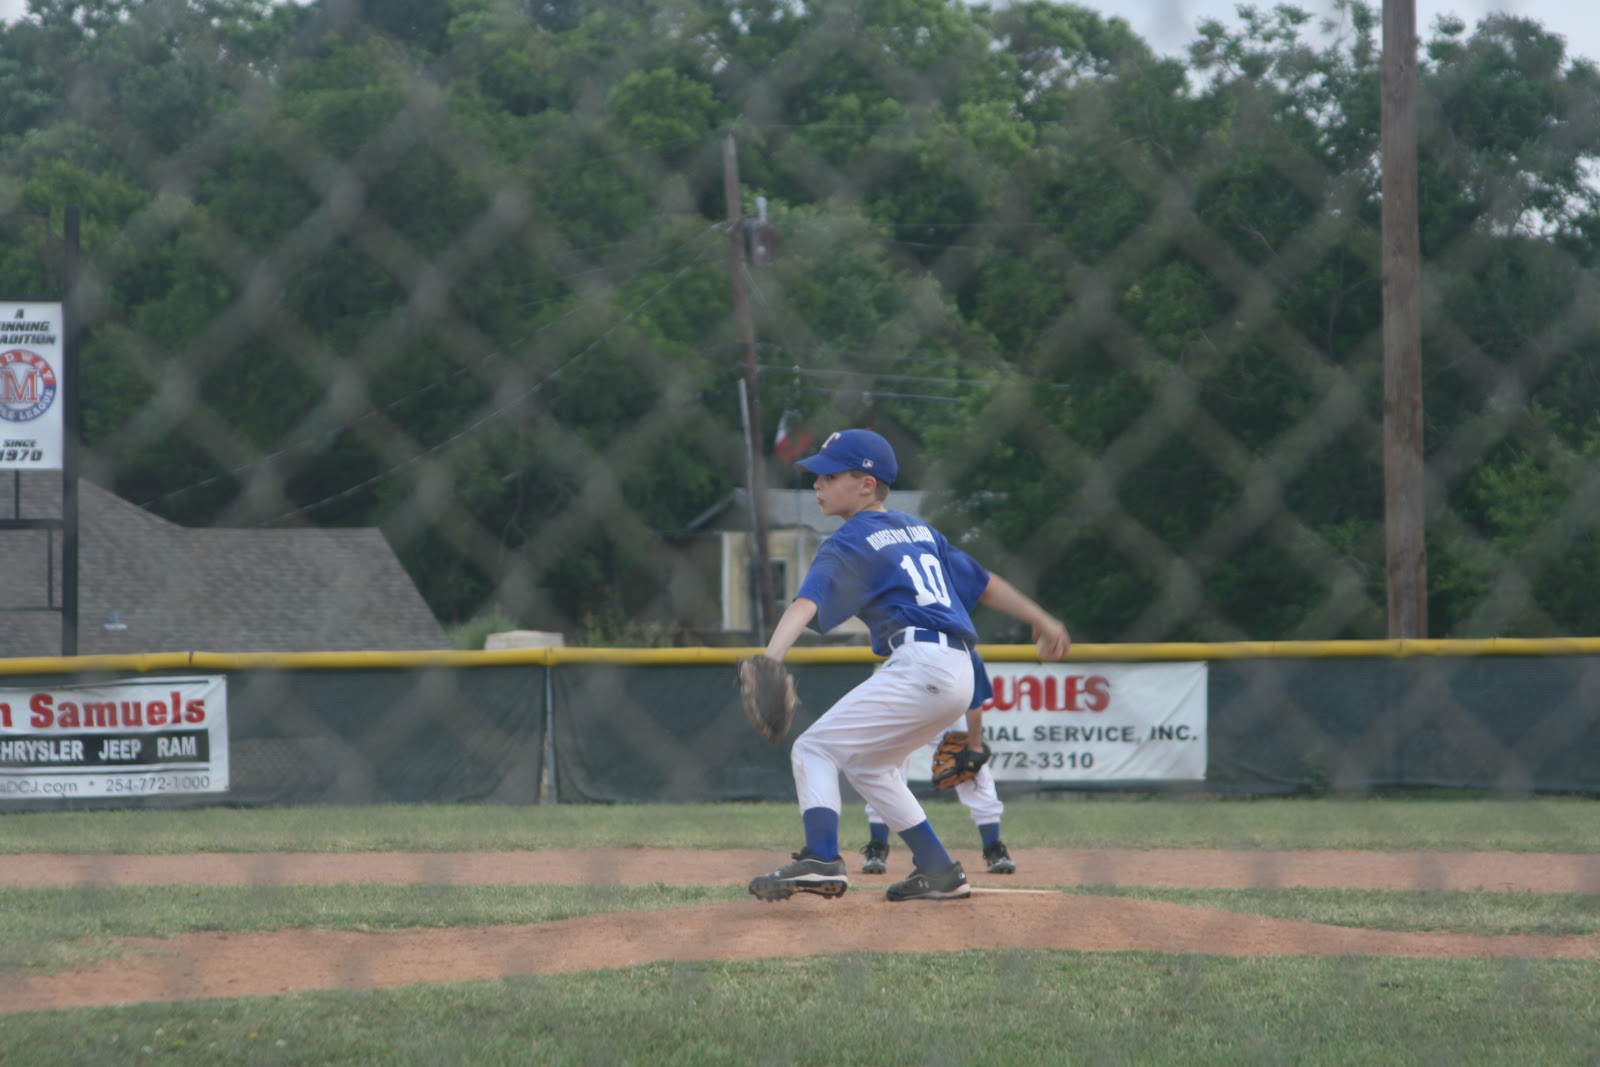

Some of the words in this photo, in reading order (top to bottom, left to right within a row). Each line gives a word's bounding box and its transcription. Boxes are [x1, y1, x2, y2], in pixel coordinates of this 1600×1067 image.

[14, 308, 24, 319] A
[0, 321, 50, 331] INNING
[0, 334, 56, 345] ADITION
[3, 439, 36, 448] SINCE
[0, 449, 43, 461] 1970
[900, 553, 951, 608] 10
[29, 691, 206, 728] Samuels
[1150, 724, 1198, 741] INC.
[0, 740, 84, 762] HRYSLER
[98, 738, 142, 760] JEEP
[157, 736, 197, 757] RAM
[0, 780, 77, 793] sDCJ.com
[105, 776, 210, 792] 254-772-1000
